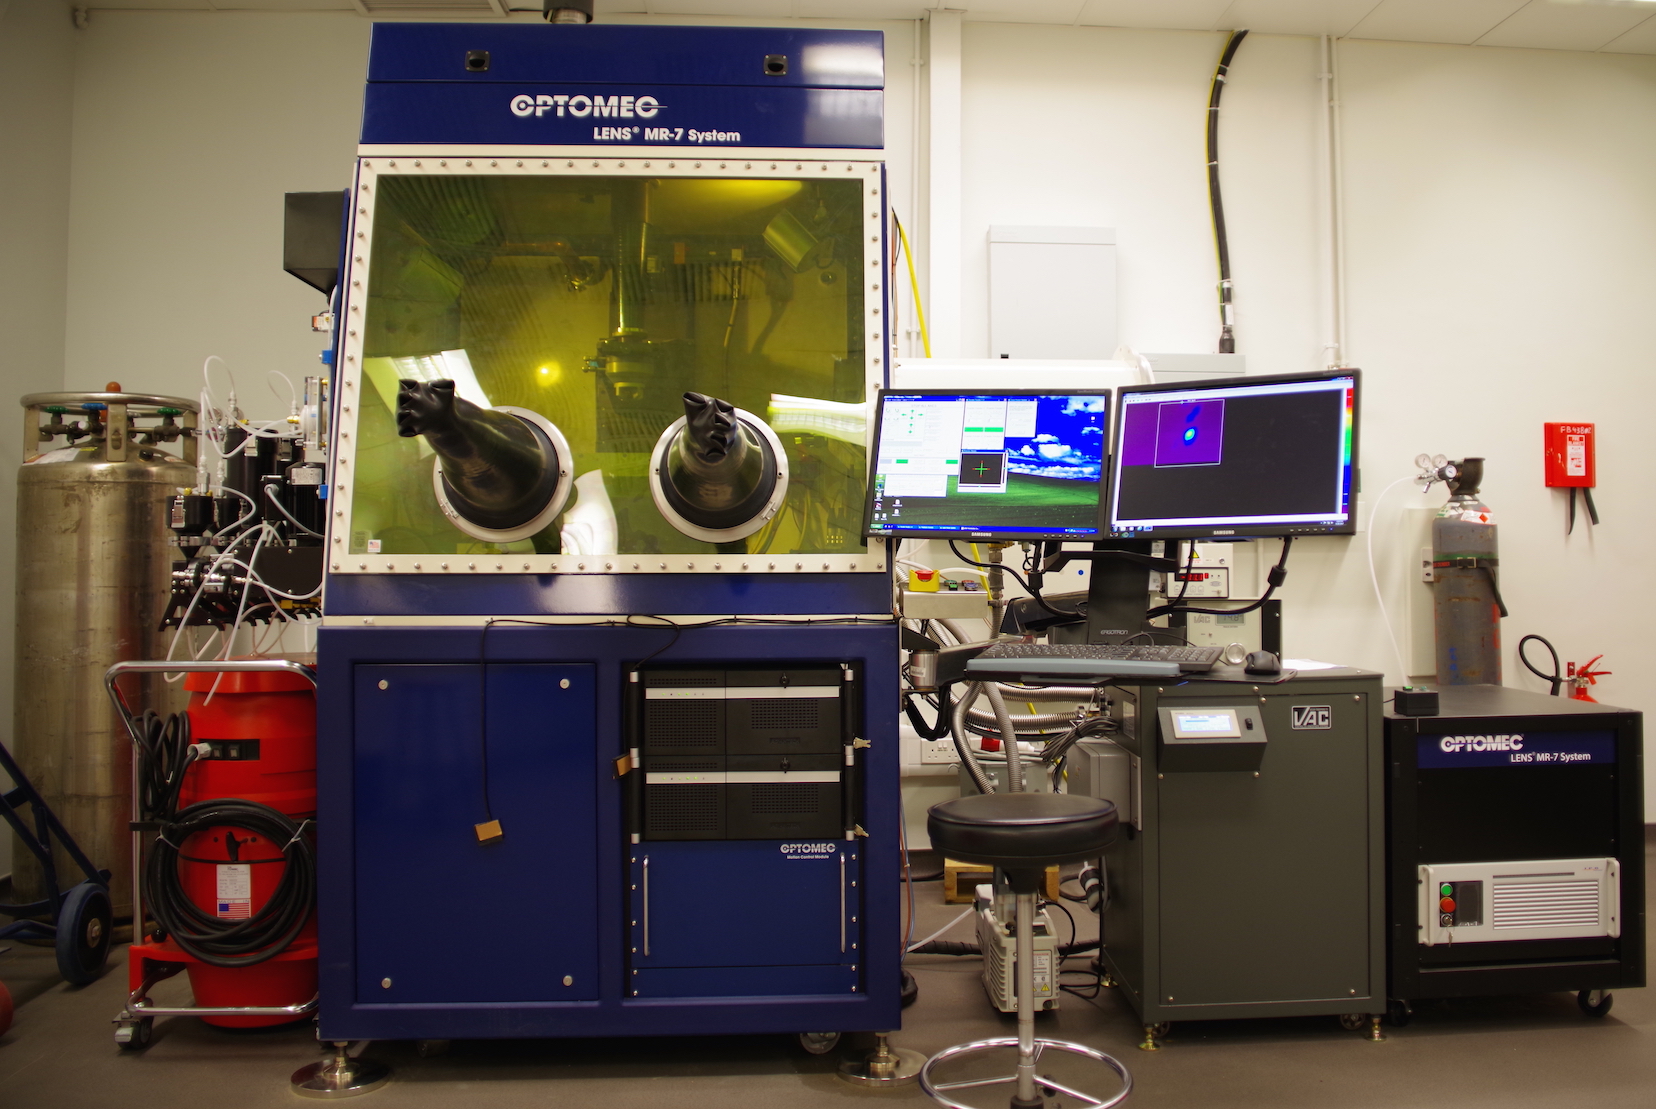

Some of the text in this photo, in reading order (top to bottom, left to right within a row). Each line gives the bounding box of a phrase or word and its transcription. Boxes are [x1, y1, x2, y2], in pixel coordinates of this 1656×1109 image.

[510, 94, 659, 118] OPTOMEC
[644, 127, 684, 141] MR-7
[688, 129, 741, 143] System
[1294, 706, 1329, 726] VAC
[1440, 734, 1524, 753] OPTOMEC
[1536, 752, 1559, 762] MR-7
[1560, 752, 1592, 763] System
[780, 843, 836, 854] OPTOMEC
